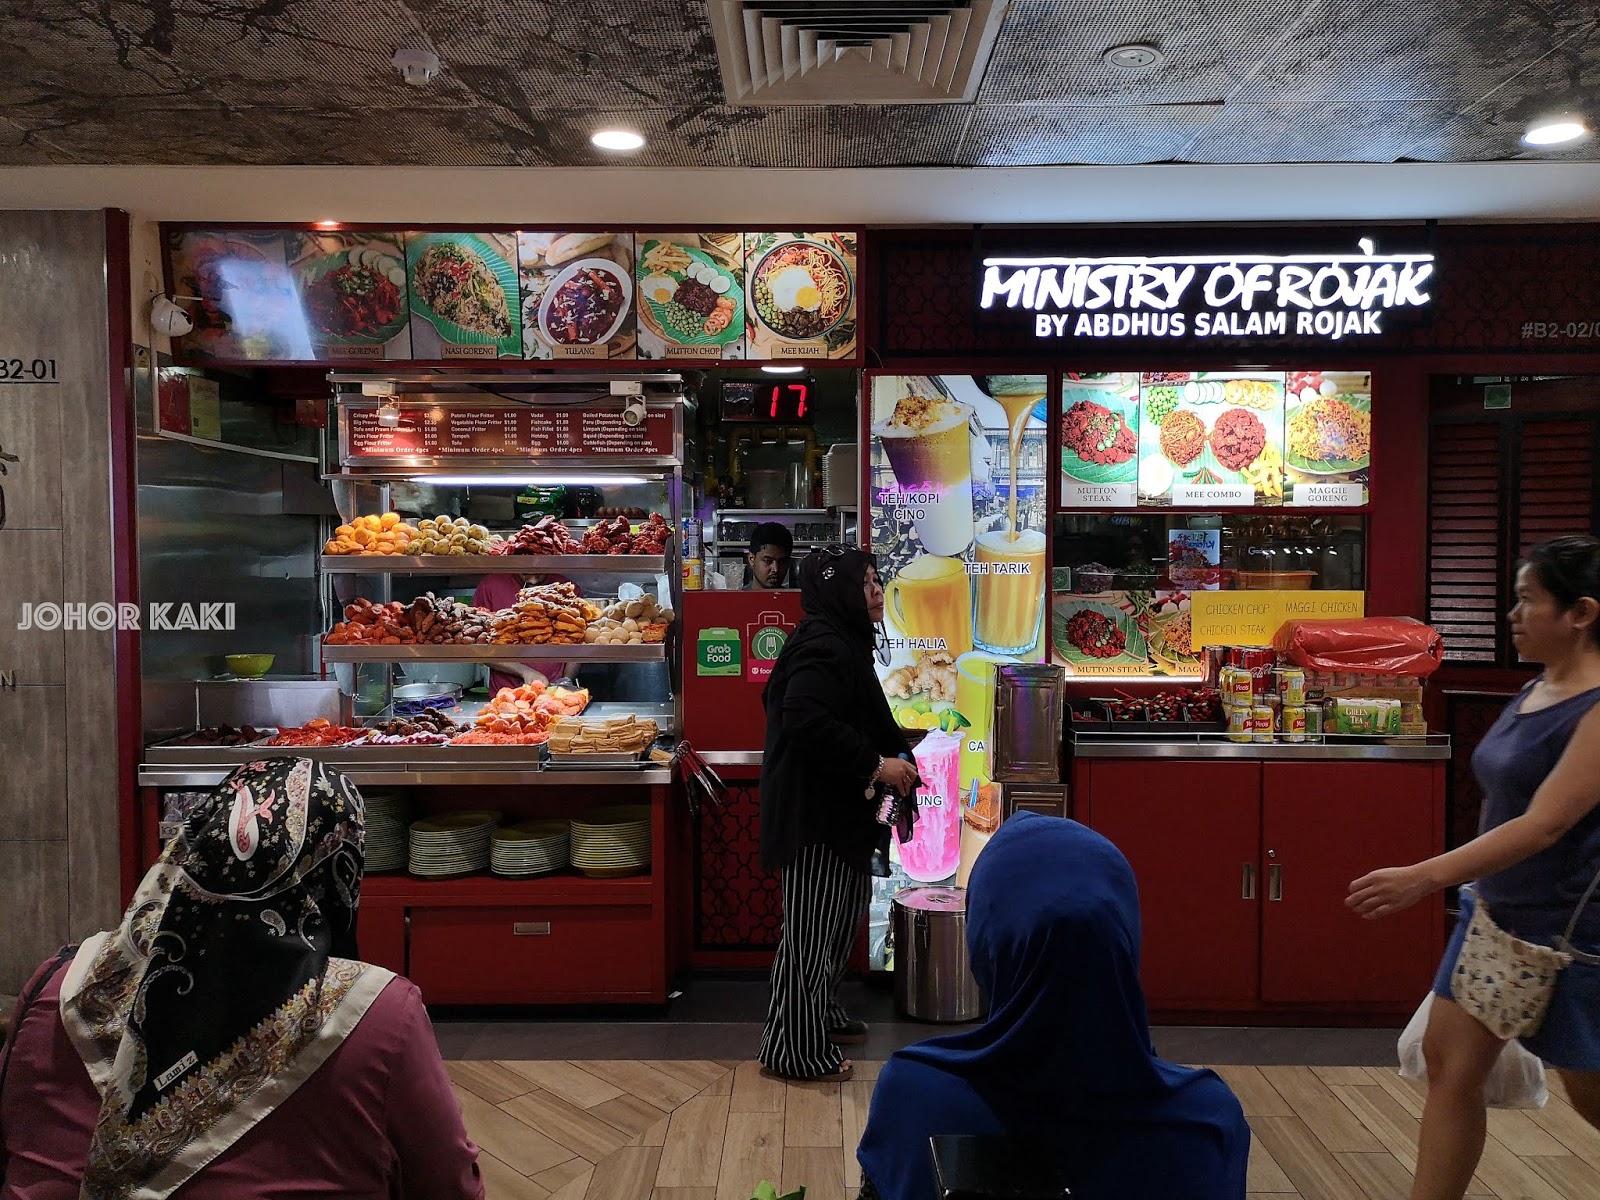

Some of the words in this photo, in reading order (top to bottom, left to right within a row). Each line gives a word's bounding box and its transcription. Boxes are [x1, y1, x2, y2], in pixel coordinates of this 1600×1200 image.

[980, 259, 1195, 310] MINISTRY
[1203, 262, 1274, 310] OF
[1276, 259, 1433, 310] ROJAK
[1035, 313, 1069, 337] BY
[1074, 312, 1186, 337] ABDHUS
[1194, 310, 1287, 337] SALAM
[1296, 310, 1383, 340] ROJAK
[348, 347, 379, 355] GORENG
[445, 347, 462, 355] NASI
[462, 347, 494, 355] GORENG
[565, 347, 595, 355] TULANG
[666, 347, 698, 355] MUTTON
[699, 347, 721, 355] CHOP
[781, 347, 798, 355] MEE
[798, 347, 820, 355] KUAH
[770, 385, 806, 418] 17
[880, 493, 939, 504] TEH/KOPI
[1307, 494, 1348, 502] GORENG
[894, 509, 925, 520] CINO
[964, 563, 988, 574] TEH
[993, 563, 1031, 574] TARIK
[1205, 604, 1244, 615] CHICKEN
[1246, 603, 1270, 614] CHOP
[1285, 602, 1316, 613] MAGGI
[1320, 602, 1358, 613] CHICKEN
[1200, 625, 1237, 636] CHICKEN
[1240, 624, 1266, 635] STEAK
[707, 643, 731, 654] Grab
[880, 638, 904, 649] TEH
[908, 638, 947, 649] HALIA
[707, 653, 731, 663] Food
[760, 667, 772, 675] foo
[1345, 707, 1368, 716] GREEN
[1350, 715, 1363, 724] TEA
[968, 741, 987, 752] CA
[157, 1055, 196, 1087] Lamiz
